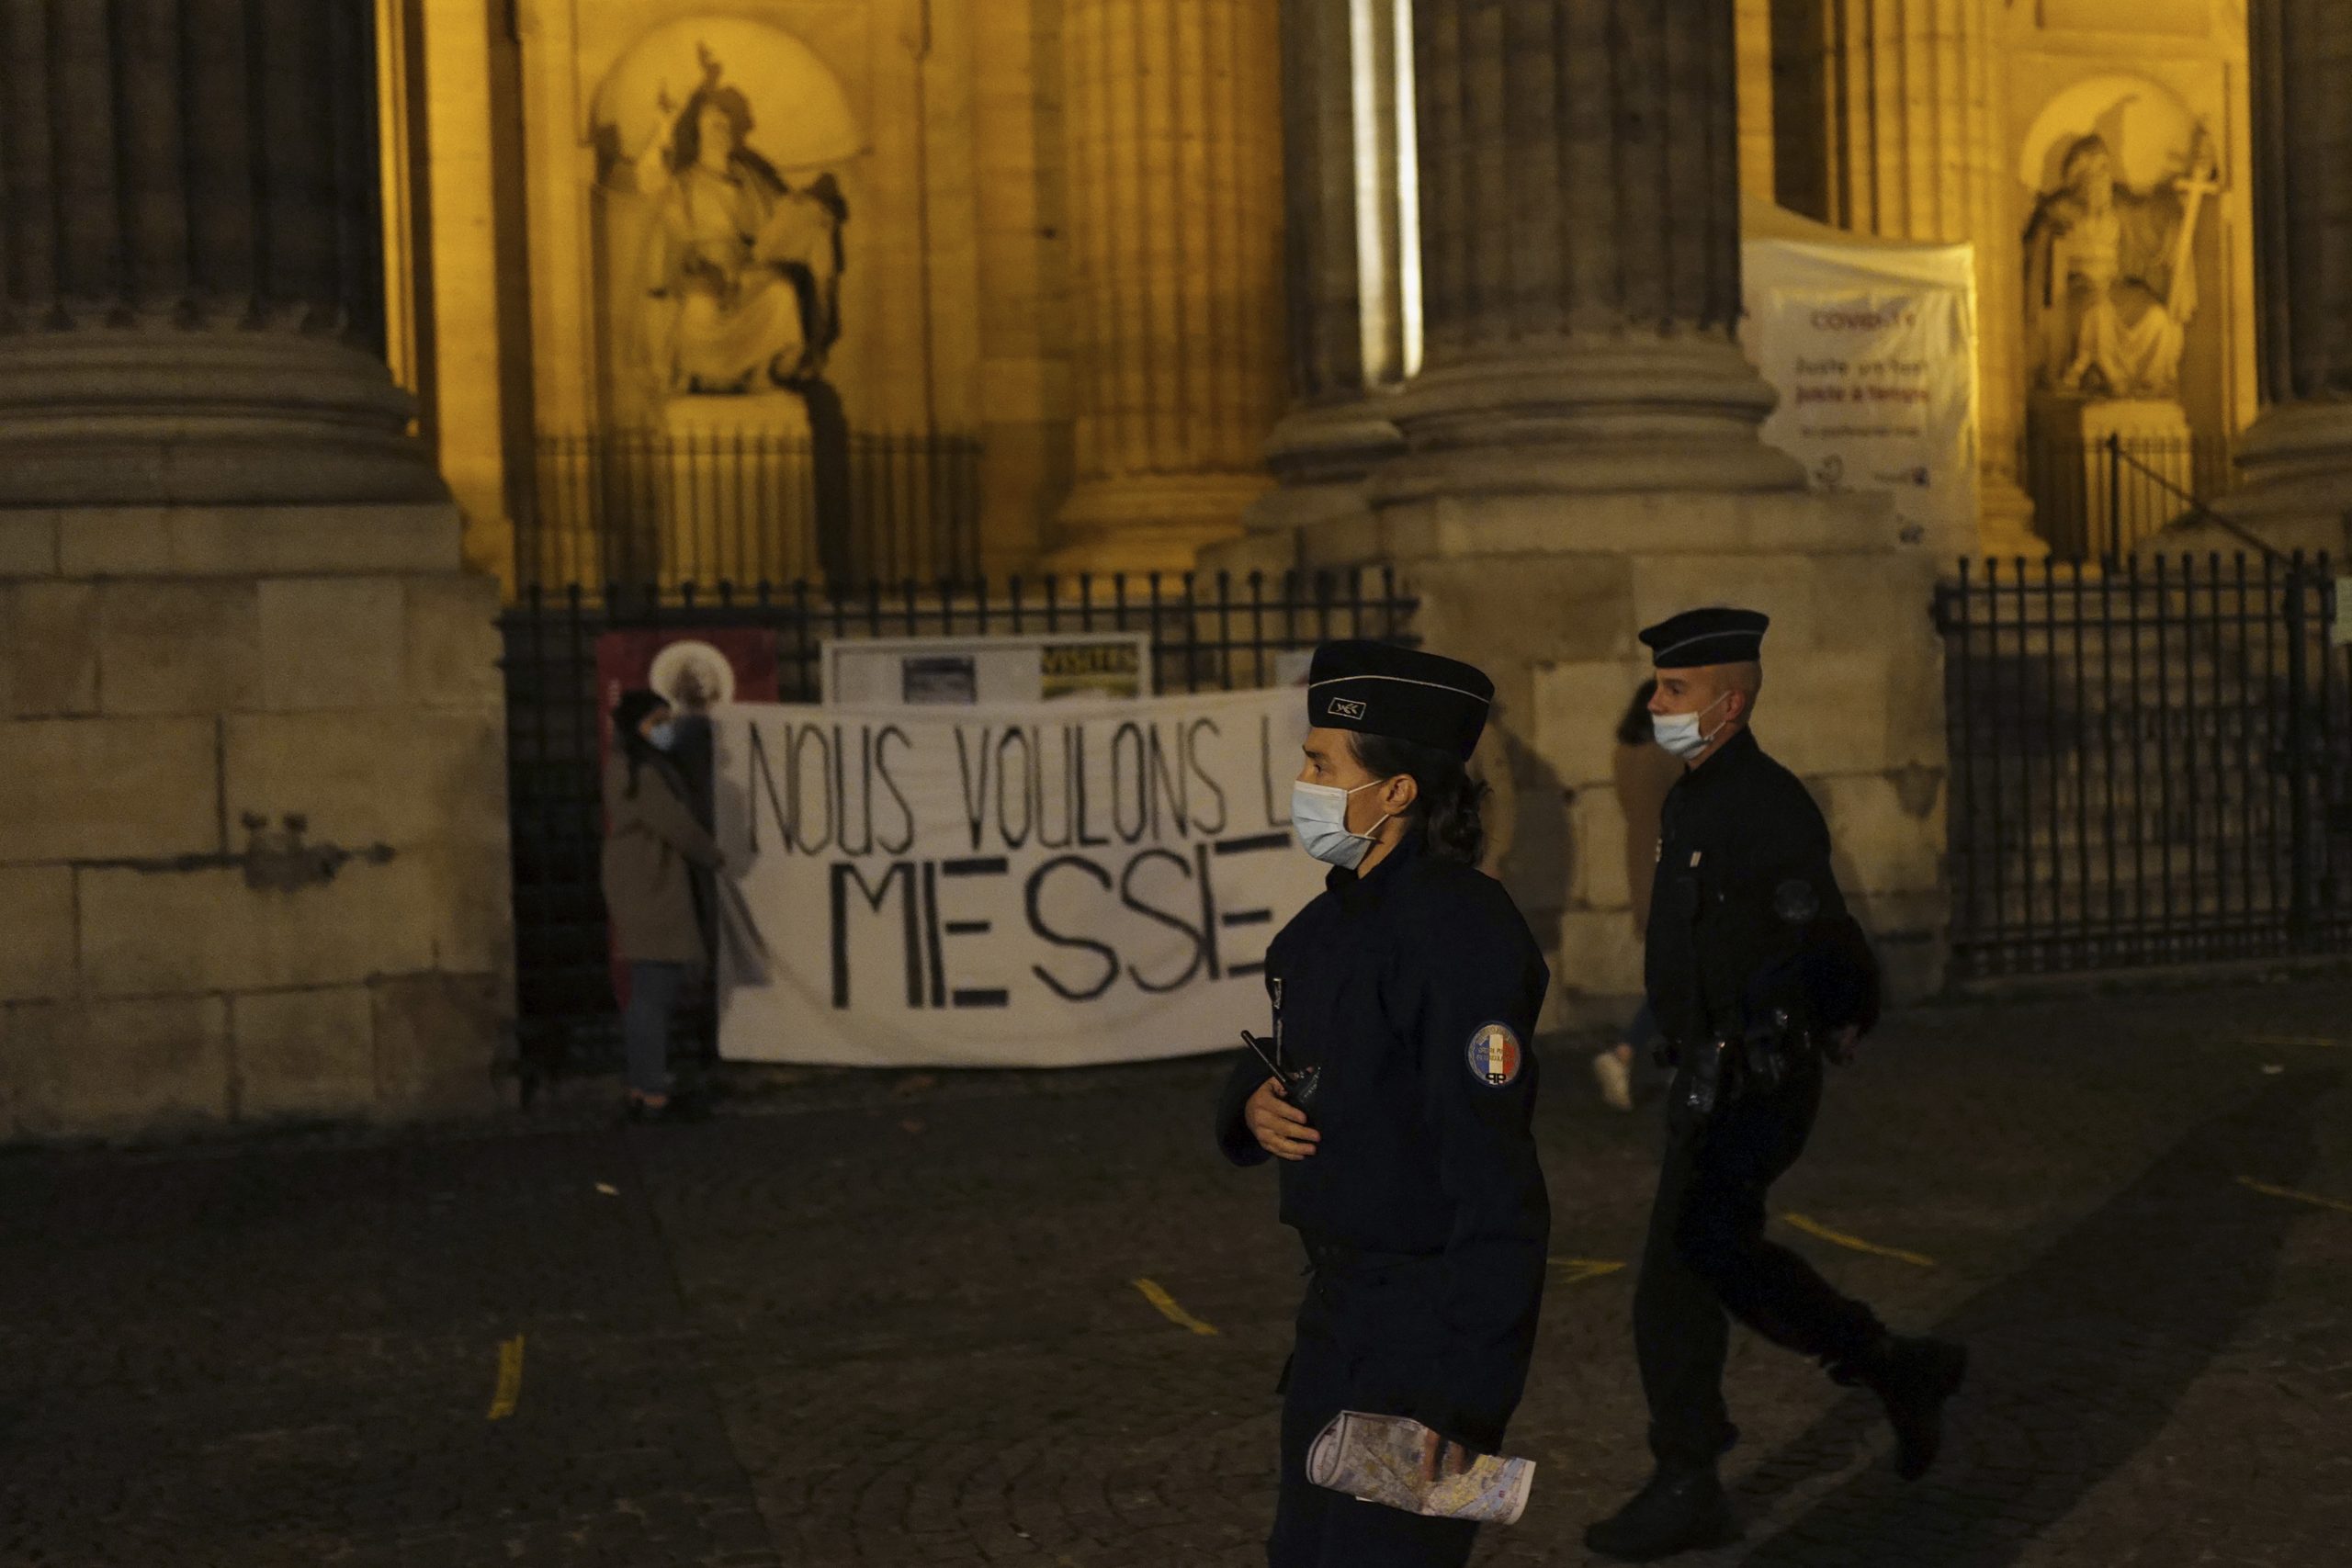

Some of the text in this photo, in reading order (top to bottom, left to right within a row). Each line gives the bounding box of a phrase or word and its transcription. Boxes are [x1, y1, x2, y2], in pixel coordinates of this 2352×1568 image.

[749, 714, 1294, 856] NOUS VOULONS L
[830, 832, 1292, 1010] MESSE
